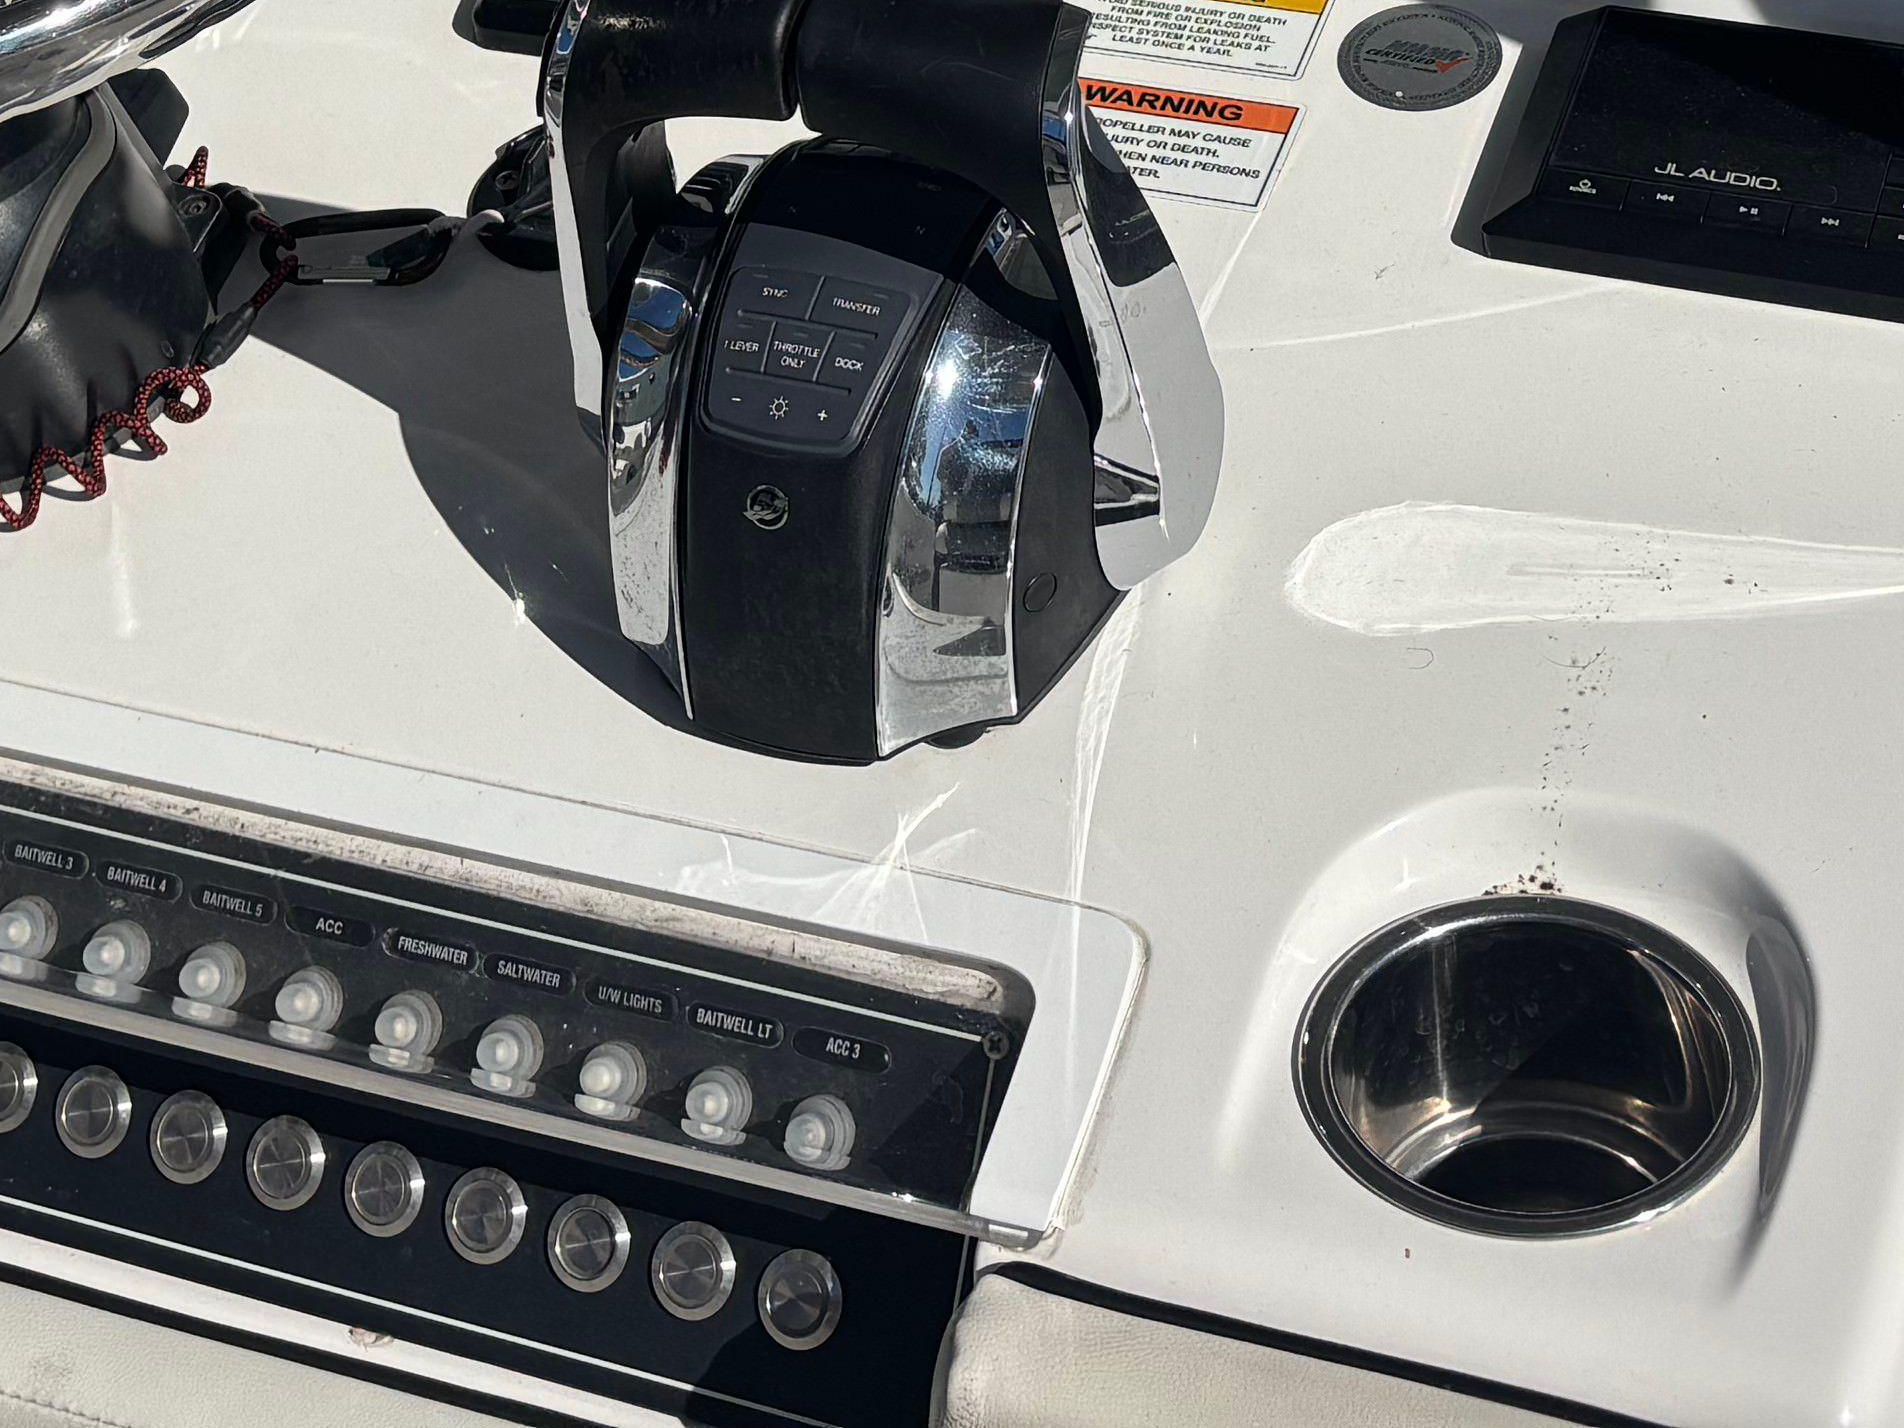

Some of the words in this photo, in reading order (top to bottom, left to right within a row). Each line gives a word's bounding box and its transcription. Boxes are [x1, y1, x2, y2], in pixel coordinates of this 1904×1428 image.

[1091, 12, 1151, 28] ESULTING
[1153, 20, 1187, 32] FROM
[1189, 24, 1242, 39] LEAKING
[1110, 5, 1144, 17] FROM
[1146, 9, 1172, 21] FIRE
[1175, 13, 1192, 23] OR
[1195, 16, 1262, 32] EXPLOSION
[1184, 5, 1226, 18] INJURY
[1227, 10, 1246, 21] OR
[1248, 13, 1288, 26] DEATH
[1112, 34, 1150, 46] LEAST
[1152, 39, 1186, 50] ONCE
[1187, 44, 1197, 52] A
[1136, 27, 1184, 42] SYSTEM
[1186, 33, 1211, 44] FOR
[1213, 37, 1252, 51] LEAKS
[1254, 44, 1271, 53] AT
[1085, 84, 1244, 122] WARNING
[1096, 117, 1167, 136] OPELLER
[1169, 127, 1201, 140] MAY
[1203, 132, 1253, 148] CAUSE
[1105, 132, 1145, 146] JURY
[1147, 139, 1168, 150] OR
[1170, 142, 1220, 158] DEATH.
[1117, 149, 1147, 162] HEN
[1150, 153, 1189, 168] NEAR
[1192, 160, 1261, 179] PERSONS
[1128, 166, 1161, 179] ATER.
[1654, 162, 1685, 176] JL
[832, 297, 881, 316] TRANSFER
[729, 340, 760, 352] LEVER
[773, 340, 821, 358] THROTTLE
[780, 355, 806, 369] ONLY
[834, 357, 864, 371] DOCK
[14, 844, 63, 868] BAITWELL
[65, 857, 74, 871] 3
[107, 866, 156, 890] BAITWELL
[158, 879, 167, 893] 4
[203, 890, 252, 914] BAITWELL
[255, 904, 263, 918] 5
[315, 917, 344, 935] ACC
[398, 936, 469, 965] FRESHWATER
[497, 960, 561, 988] SALTWATER
[598, 986, 621, 1003] U/W
[623, 993, 663, 1014] LIGHTS
[696, 1007, 753, 1036] BAITWELL
[757, 1022, 773, 1040] LT
[825, 1037, 851, 1057] ACC
[852, 1044, 861, 1059] 3
